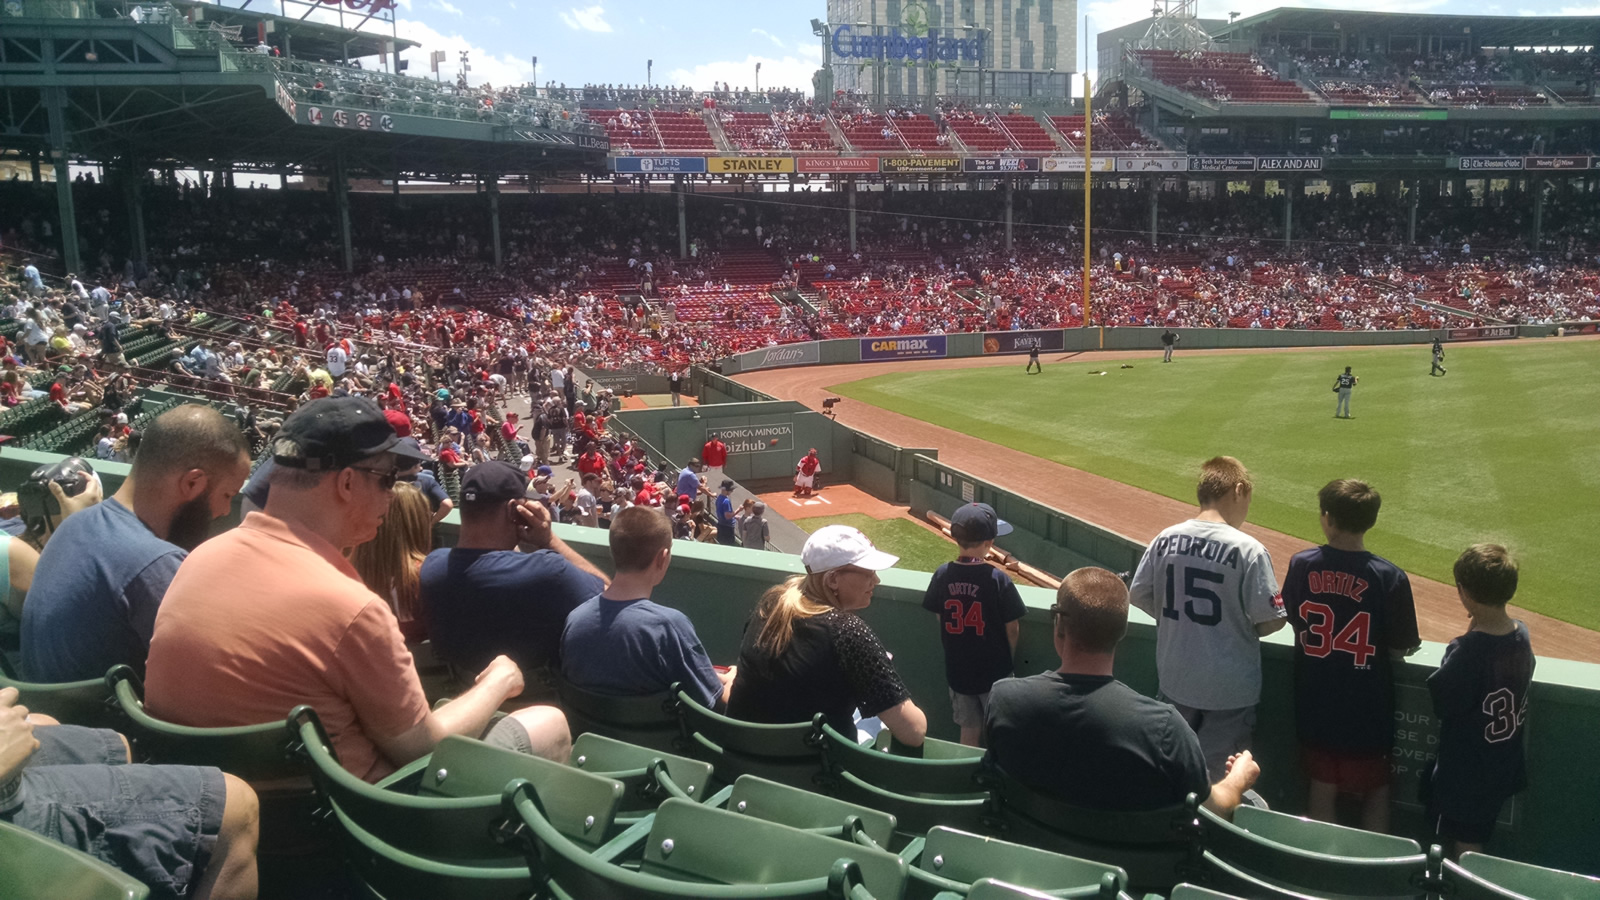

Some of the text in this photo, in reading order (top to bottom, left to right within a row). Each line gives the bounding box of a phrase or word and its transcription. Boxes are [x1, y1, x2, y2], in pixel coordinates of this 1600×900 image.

[831, 23, 984, 60] Cumberland
[309, 109, 394, 130] 14 45 26 42
[653, 158, 680, 166] TUFTS
[722, 159, 782, 170] STANLEY
[805, 159, 870, 167] KING'S HAWAIIAN
[883, 159, 960, 167] 1-800-PAVEMENT
[1260, 159, 1319, 169] ALEX AND ANI
[1473, 159, 1521, 168] The Boston Globe
[760, 348, 804, 365] Jordan's
[1341, 378, 1350, 386] 25
[720, 426, 792, 439] KONICA MINOLTA
[724, 440, 766, 453] bizhub
[1156, 534, 1240, 570] PEDROIA
[947, 582, 980, 597] ORTIZ
[1308, 570, 1369, 603] ORTIZ
[1162, 563, 1225, 627] 15
[944, 599, 986, 636] 34
[1299, 600, 1376, 667] 34
[1393, 711, 1430, 726] OUR
